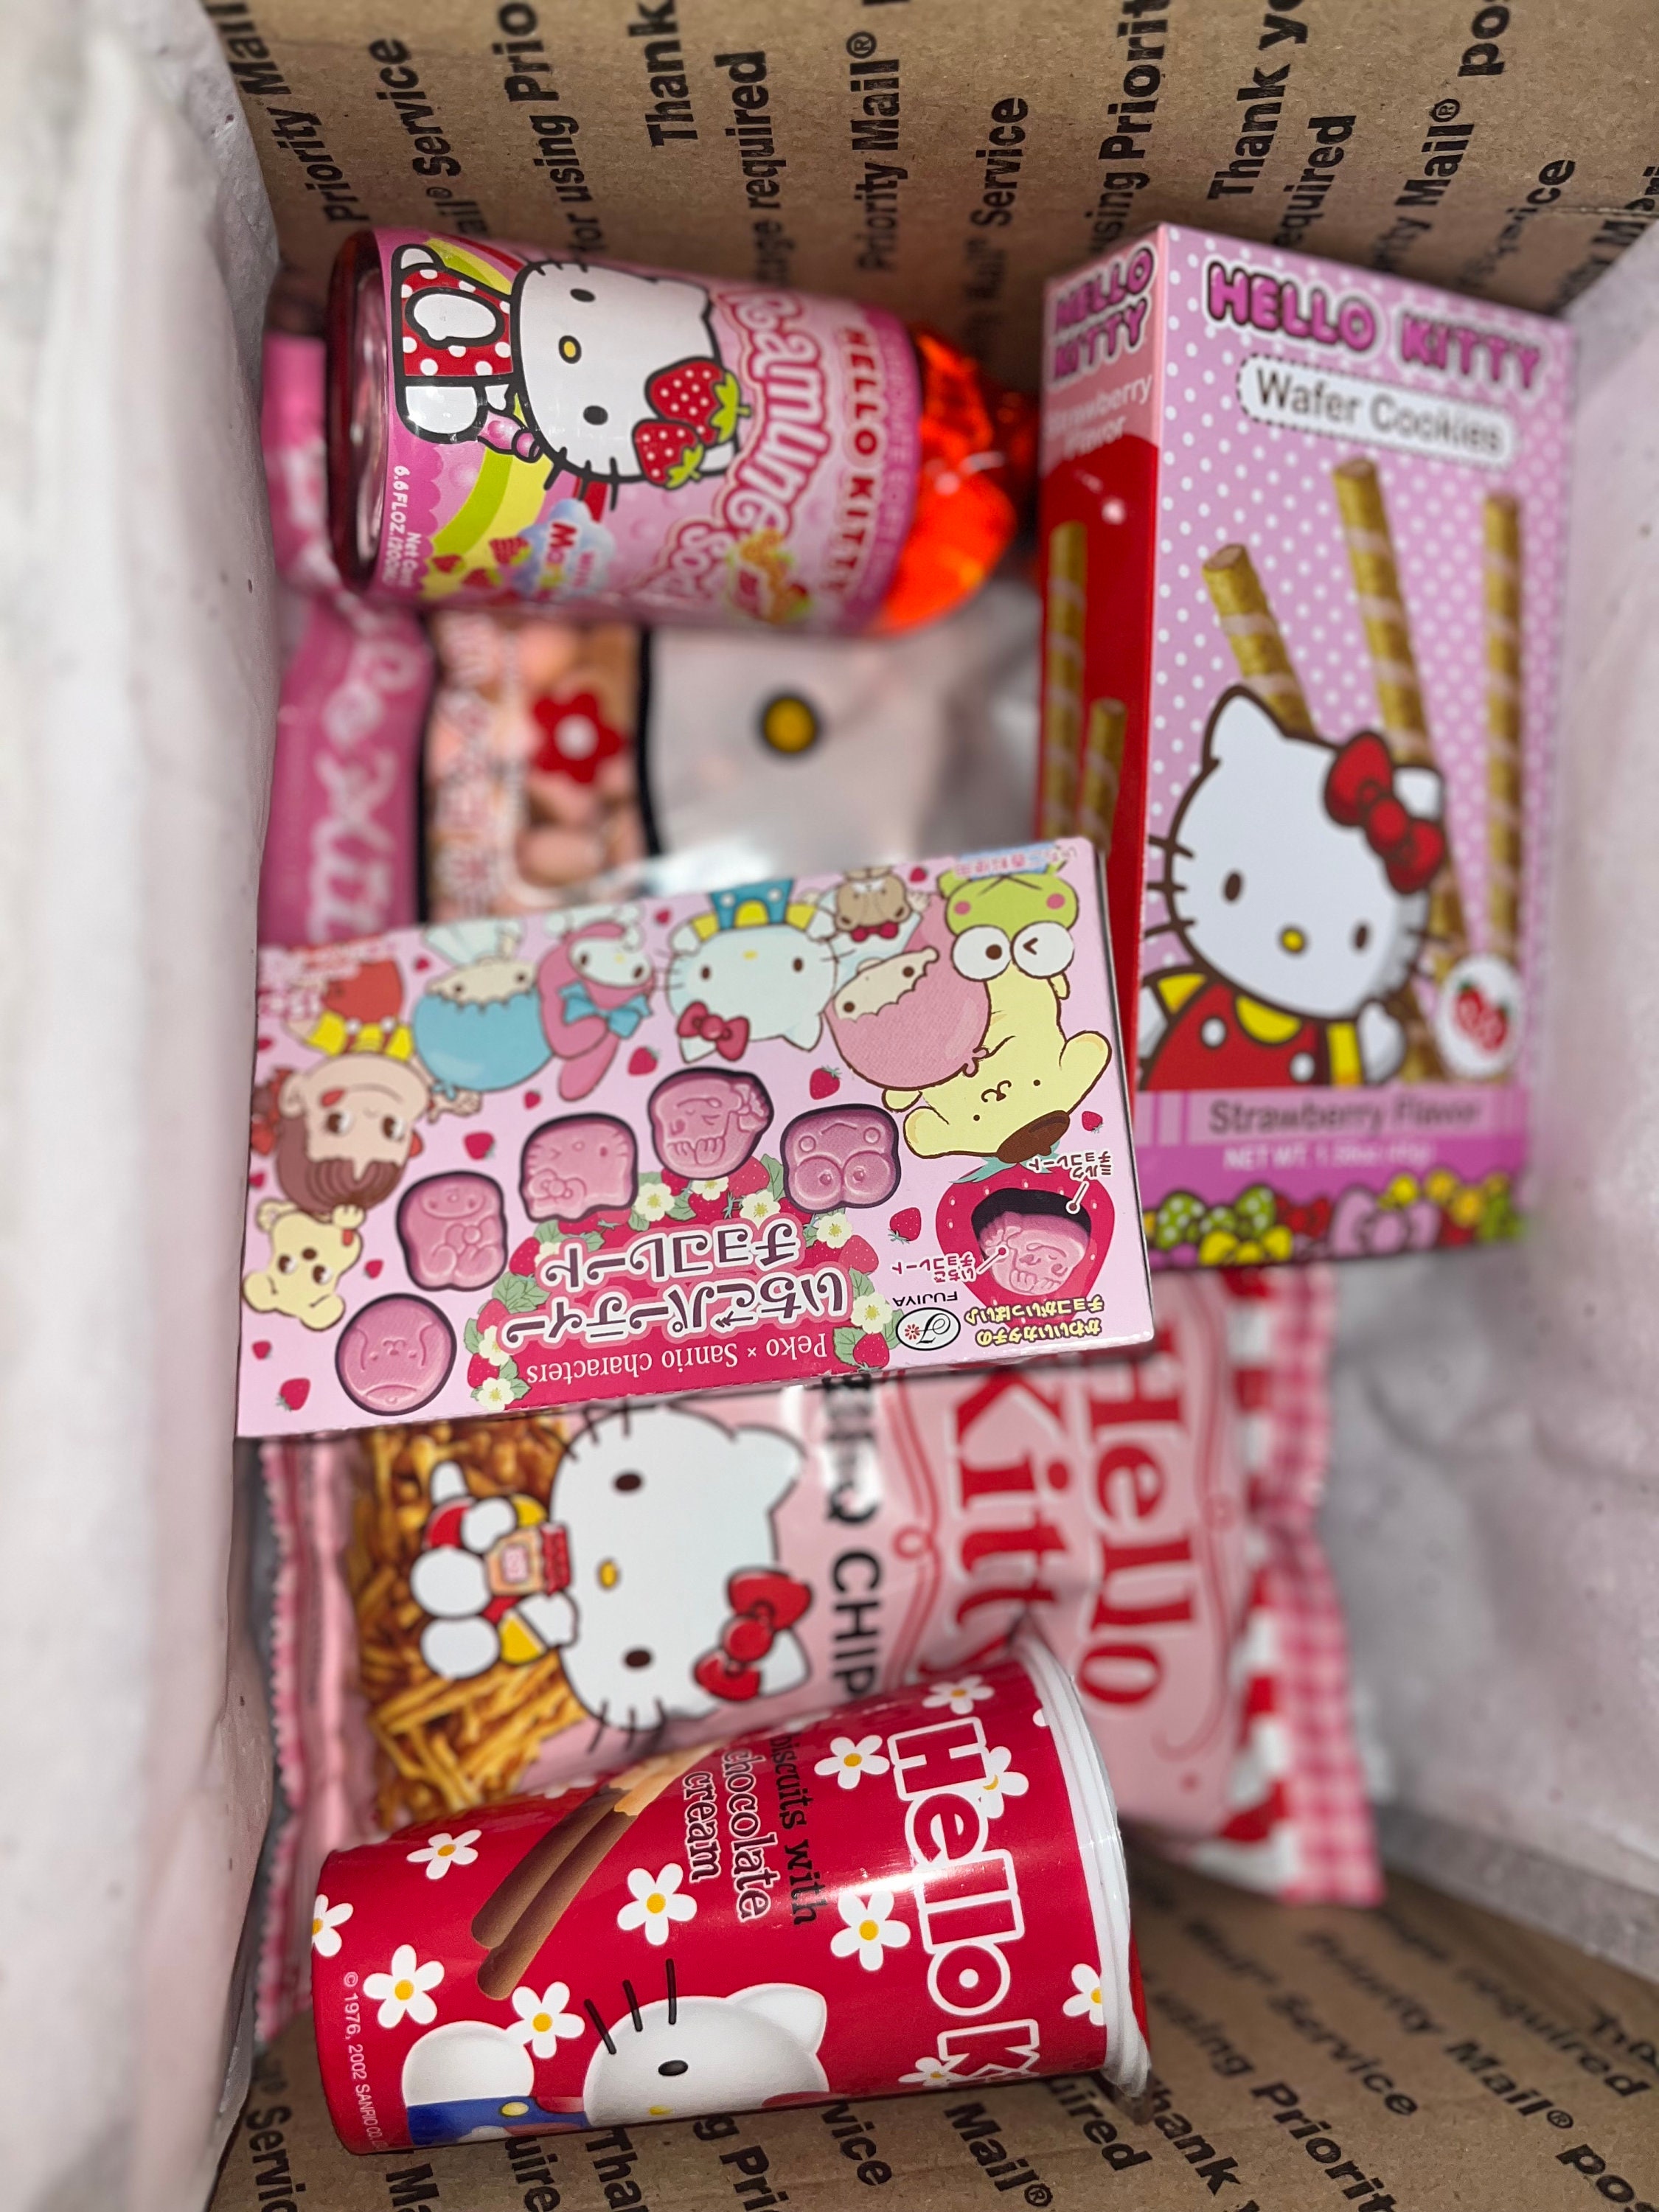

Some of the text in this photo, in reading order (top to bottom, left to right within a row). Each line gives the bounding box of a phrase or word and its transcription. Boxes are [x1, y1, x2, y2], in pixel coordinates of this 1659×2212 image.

[492, 2, 560, 102] Prio
[627, 0, 698, 147] Thank
[368, 37, 462, 178] Service
[714, 51, 787, 210] required
[846, 31, 908, 271] Priority Mail®
[1206, 63, 1291, 200] Thank
[1394, 97, 1474, 207] Mail®
[266, 106, 372, 223] Priority
[529, 114, 593, 204] using
[970, 97, 1029, 228] Service
[1207, 261, 1542, 392] HELLO KITTY
[717, 292, 832, 540] Ramune
[844, 328, 878, 456] HELLO
[1256, 366, 1503, 453] Wafer Cookies
[404, 532, 422, 557] Net
[1029, 1152, 1111, 1171] チョコレート
[1208, 1098, 1382, 1141] Strawberry
[1072, 1165, 1112, 1178] ミルク
[543, 1224, 796, 1290] チョコレート
[892, 1254, 973, 1275] チョコレート
[892, 1291, 958, 1307] FUJIYA
[933, 1268, 974, 1283] いちご
[506, 1272, 844, 1345] いちごパーティー
[765, 1333, 827, 1361] Peko
[975, 1318, 1102, 1348] かわいいカタチの
[526, 1352, 653, 1385] characters
[661, 1342, 738, 1373] Sanrio
[682, 1771, 721, 1883] cream
[721, 1750, 780, 1923] chocolate
[769, 1734, 828, 1925] biscuits with
[887, 1717, 1025, 2017] Hello
[344, 1992, 361, 2040] 1976,
[347, 2044, 366, 2080] 2002
[355, 2084, 378, 2125] SANRIO
[1446, 2038, 1574, 2129] Mail®
[944, 2101, 1054, 2208] Mail®
